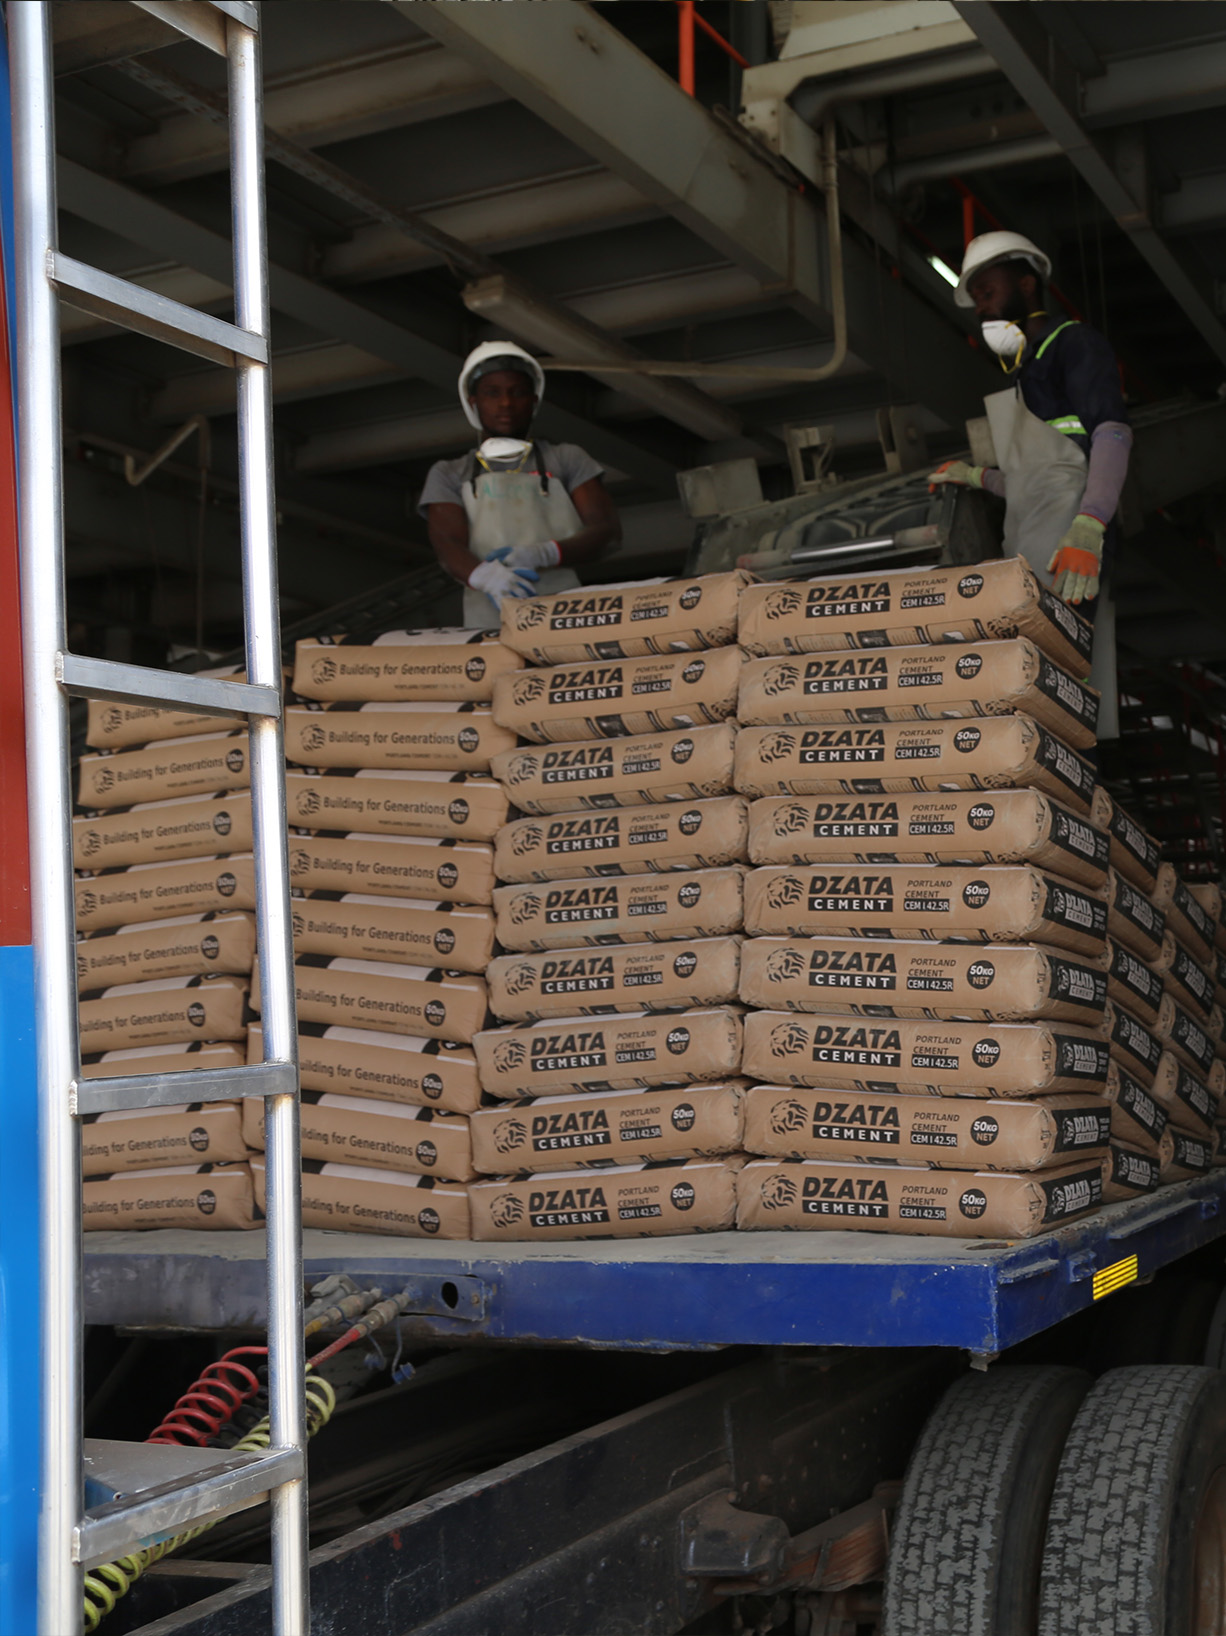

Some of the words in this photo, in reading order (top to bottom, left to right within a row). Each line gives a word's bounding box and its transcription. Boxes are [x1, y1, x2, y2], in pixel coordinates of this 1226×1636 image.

[904, 578, 947, 587] PORTLAND
[807, 582, 891, 602] DZATA
[902, 588, 936, 596] CEMENT
[963, 586, 978, 594] NET
[552, 596, 623, 615] DZATA
[812, 601, 884, 615] CEMENT
[902, 599, 918, 608] CEM
[923, 596, 945, 606] 42.5R
[555, 615, 617, 628] CEMENT
[902, 656, 945, 664] PORTLAND
[340, 664, 380, 677] Building
[383, 664, 398, 675] for
[401, 663, 462, 675] Generations
[804, 658, 888, 678] DZATA
[900, 666, 933, 674] CEMENT
[961, 667, 976, 675] NET
[550, 668, 623, 689] DZATA
[899, 677, 914, 685] CEM
[921, 675, 942, 684] 42.5R
[810, 679, 881, 692] CEMENT
[554, 688, 618, 702] CEMENT
[329, 732, 369, 745] Building
[373, 732, 389, 744] for
[392, 732, 455, 744] Generations
[801, 730, 885, 747] DZATA
[959, 740, 976, 748] NET
[542, 747, 613, 768] DZATA
[806, 750, 878, 761] CEMENT
[896, 749, 912, 758] CEM
[918, 747, 940, 756] 42.5R
[117, 766, 152, 782] Building
[155, 764, 168, 775] for
[170, 758, 223, 774] Generations
[547, 767, 608, 781] CEMENT
[324, 797, 363, 812] Building
[367, 799, 381, 810] for
[384, 800, 445, 815] Generations
[814, 803, 899, 821] DZATA
[547, 817, 620, 839] DZATA
[820, 825, 892, 836] CEMENT
[910, 825, 926, 834] CEM
[932, 824, 954, 833] 42.5R
[552, 838, 614, 852] CEMENT
[313, 858, 353, 873] Building
[356, 861, 370, 873] for
[373, 863, 434, 879] Generations
[809, 876, 893, 896] DZATA
[546, 886, 618, 908] DZATA
[969, 896, 985, 904] NET
[814, 900, 887, 910] CEMENT
[905, 902, 921, 910] CEM
[927, 902, 949, 910] 42.5R
[1065, 893, 1092, 917] DZATA
[550, 908, 613, 921] CEMENT
[1067, 910, 1091, 926] CEMENT
[308, 921, 348, 937] Building
[352, 924, 365, 937] for
[369, 927, 431, 944] Generations
[91, 956, 126, 970] Building
[128, 952, 141, 962] for
[145, 944, 198, 960] Generations
[810, 950, 897, 973] DZATA
[911, 958, 956, 966] PORTLAND
[541, 957, 614, 979] DZATA
[909, 969, 943, 977] CEMENT
[546, 979, 609, 992] CEMENT
[815, 974, 890, 988] CEMENT
[908, 980, 924, 989] CEM
[930, 981, 953, 990] 42.5R
[973, 976, 989, 984] NET
[1069, 969, 1095, 989] DZATA
[1071, 987, 1093, 999] CEMENT
[296, 989, 337, 1007] Building
[340, 993, 355, 1006] for
[358, 996, 422, 1016] Generations
[531, 1032, 605, 1056] DZATA
[814, 1025, 901, 1050] DZATA
[916, 1035, 962, 1044] PORTLAND
[913, 1046, 948, 1054] CEMENT
[1073, 1044, 1097, 1062] DZATA
[537, 1055, 601, 1070] CEMENT
[819, 1050, 894, 1065] CEMENT
[912, 1057, 929, 1066] CEM
[935, 1058, 958, 1068] 42.5R
[978, 1055, 995, 1063] NET
[1076, 1062, 1096, 1072] CEMENT
[300, 1059, 334, 1077] uilding
[337, 1065, 353, 1077] for
[355, 1068, 419, 1089] Generations
[813, 1102, 900, 1127] DZATA
[914, 1112, 960, 1121] PORTLAND
[532, 1110, 609, 1136] DZATA
[912, 1123, 947, 1132] CEMENT
[1074, 1116, 1098, 1132] DZATA
[819, 1127, 893, 1142] CEMENT
[911, 1134, 928, 1143] CEM
[934, 1136, 957, 1145] 42.5R
[976, 1133, 993, 1141] NET
[1076, 1132, 1097, 1143] CEMENT
[301, 1127, 329, 1144] ilding
[332, 1131, 346, 1144] for
[350, 1135, 413, 1156] Generations
[539, 1134, 605, 1149] CEMENT
[618, 1186, 660, 1196] PORTLAND
[802, 1177, 889, 1201] DZATA
[902, 1186, 948, 1195] PORTLAND
[1064, 1180, 1091, 1200] DZATA
[529, 1188, 607, 1212] DZATA
[618, 1198, 649, 1207] CEMENT
[901, 1197, 936, 1205] CEMENT
[1067, 1196, 1089, 1211] CEMENT
[302, 1197, 333, 1215] uilding
[336, 1202, 350, 1214] for
[353, 1205, 416, 1223] Generations
[809, 1203, 882, 1215] CEMENT
[900, 1208, 917, 1217] CEM
[923, 1210, 946, 1219] 42.5R
[965, 1206, 981, 1215] NET
[536, 1212, 603, 1225] CEMENT
